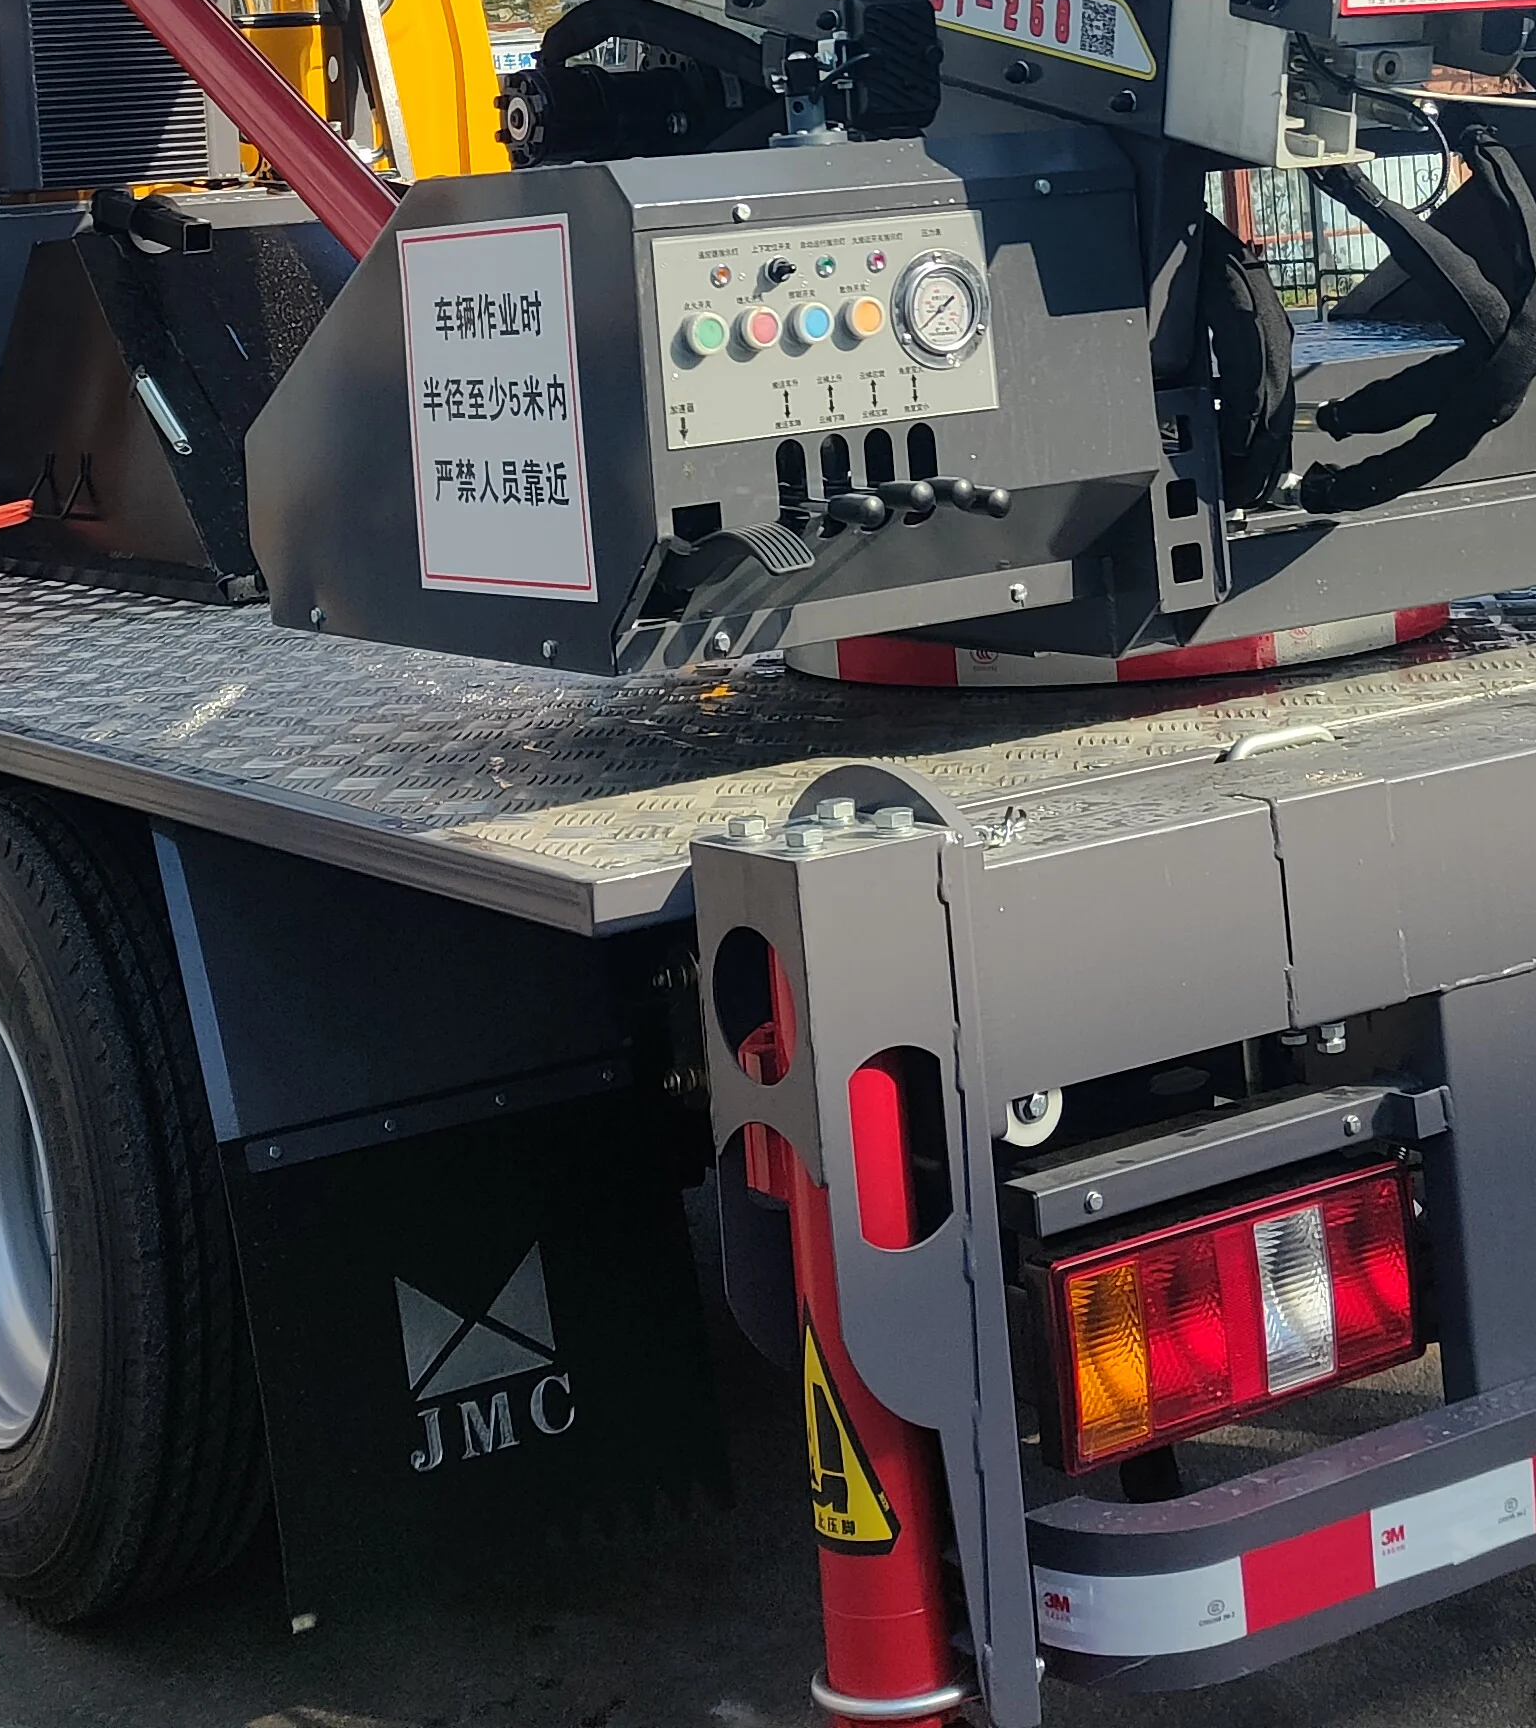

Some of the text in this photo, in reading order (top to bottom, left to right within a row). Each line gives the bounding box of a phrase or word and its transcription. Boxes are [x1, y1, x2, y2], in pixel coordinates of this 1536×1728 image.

[434, 290, 542, 341] 车辆作业时
[423, 373, 568, 422] 半径至少5米内
[434, 458, 570, 507] 严禁人员靠近
[410, 1372, 576, 1472] JMC
[1381, 1524, 1406, 1547] 3M
[1043, 1591, 1071, 1614] 3M
